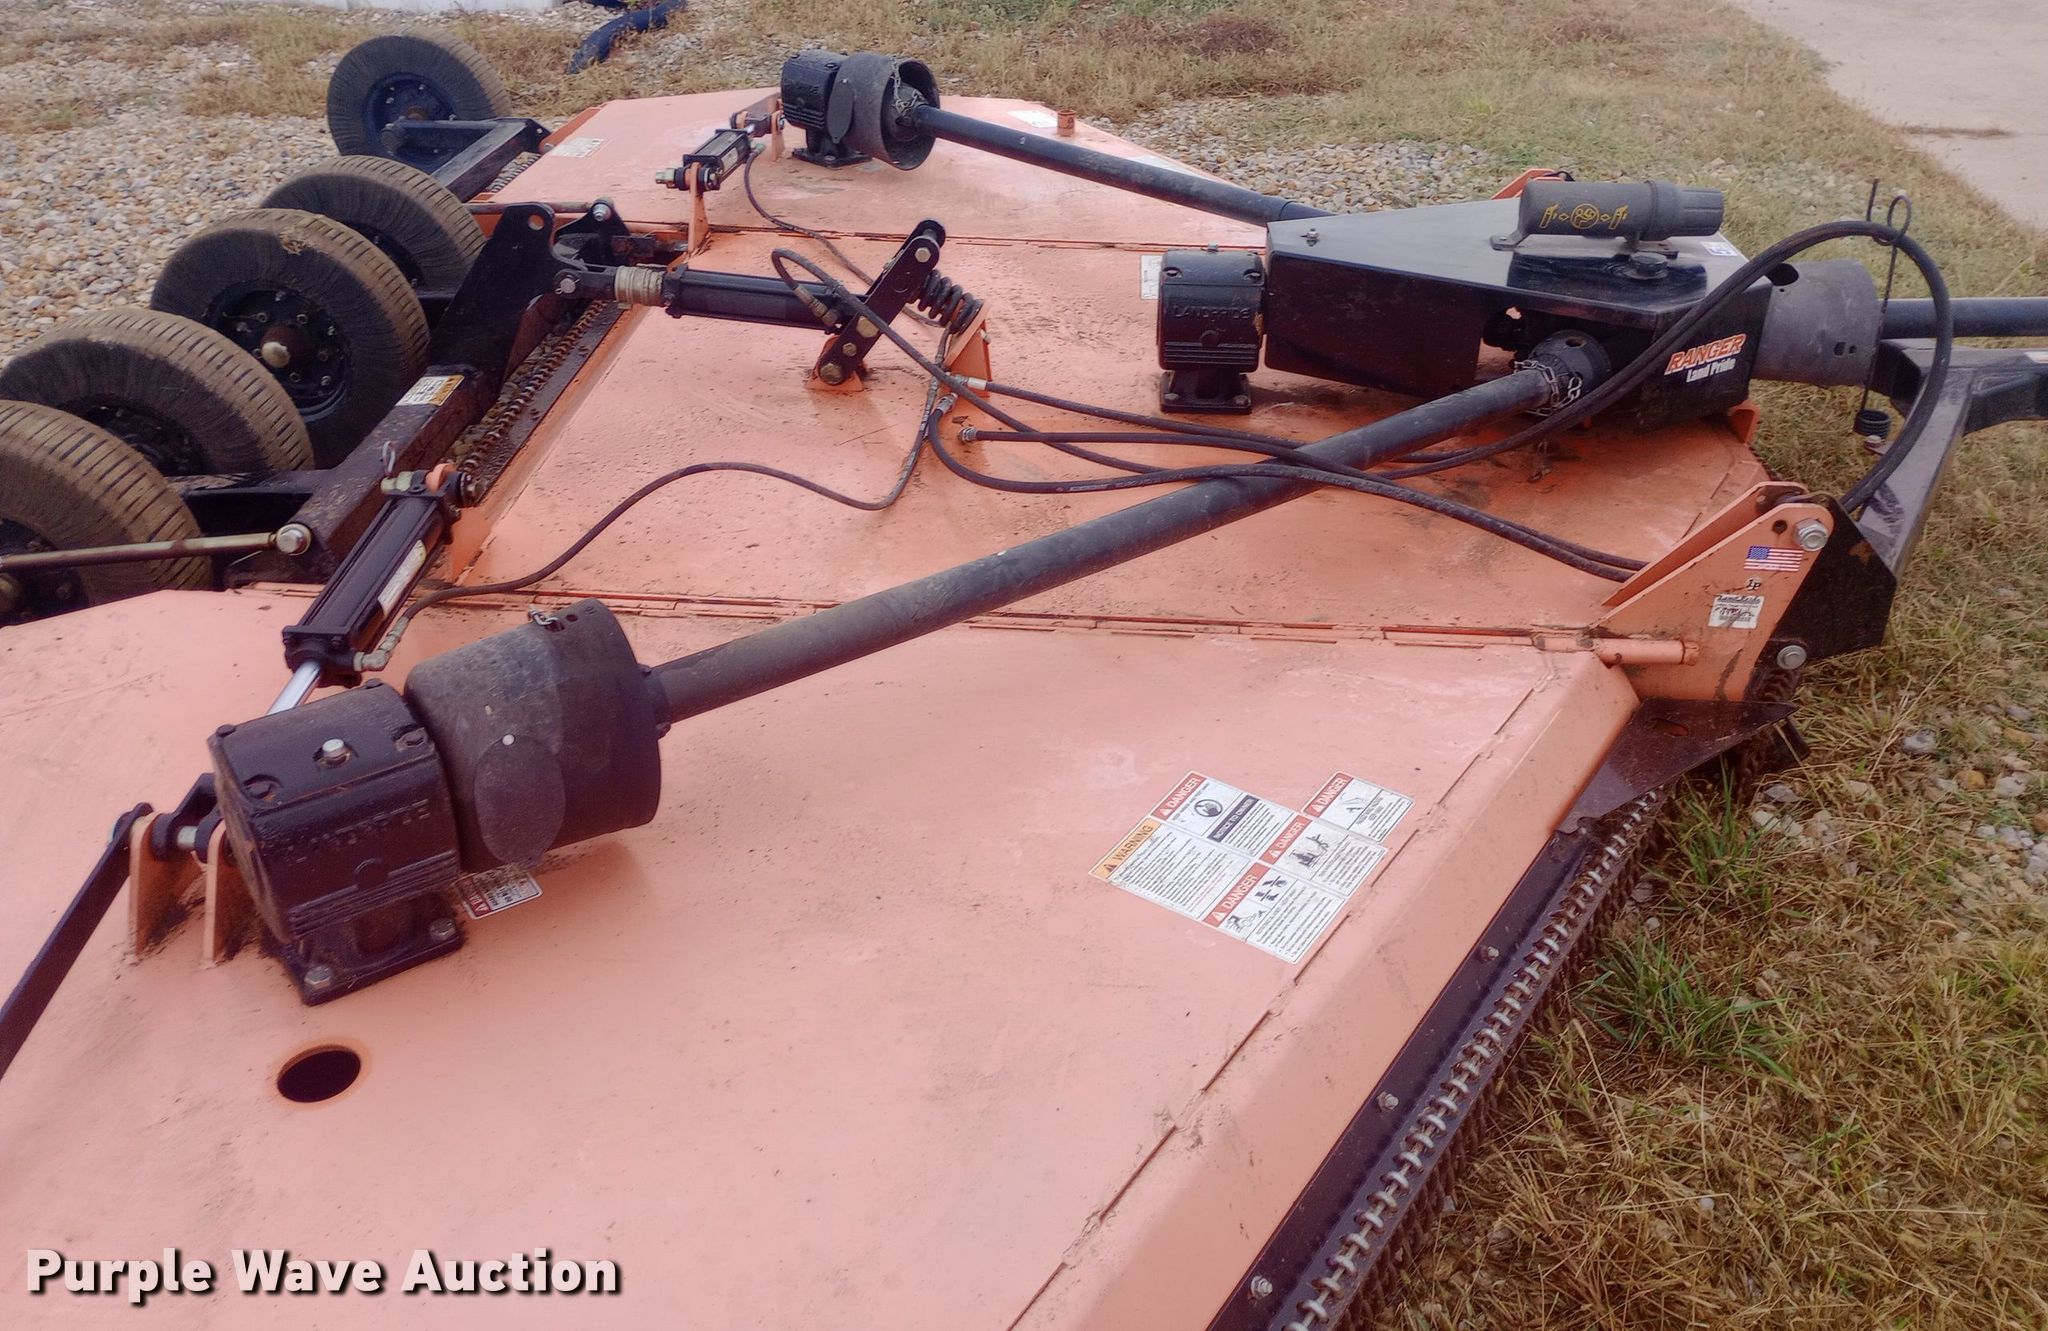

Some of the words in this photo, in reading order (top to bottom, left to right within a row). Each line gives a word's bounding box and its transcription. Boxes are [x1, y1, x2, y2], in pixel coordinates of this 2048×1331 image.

[1664, 334, 1748, 376] RANGER
[1686, 362, 1711, 383] Land
[1710, 357, 1737, 377] Pride
[1167, 777, 1202, 808] DANGER
[1319, 777, 1348, 806] DANGER
[1113, 824, 1154, 861] WARNING
[1279, 822, 1305, 849] DANGER
[1222, 873, 1259, 910] DANGER
